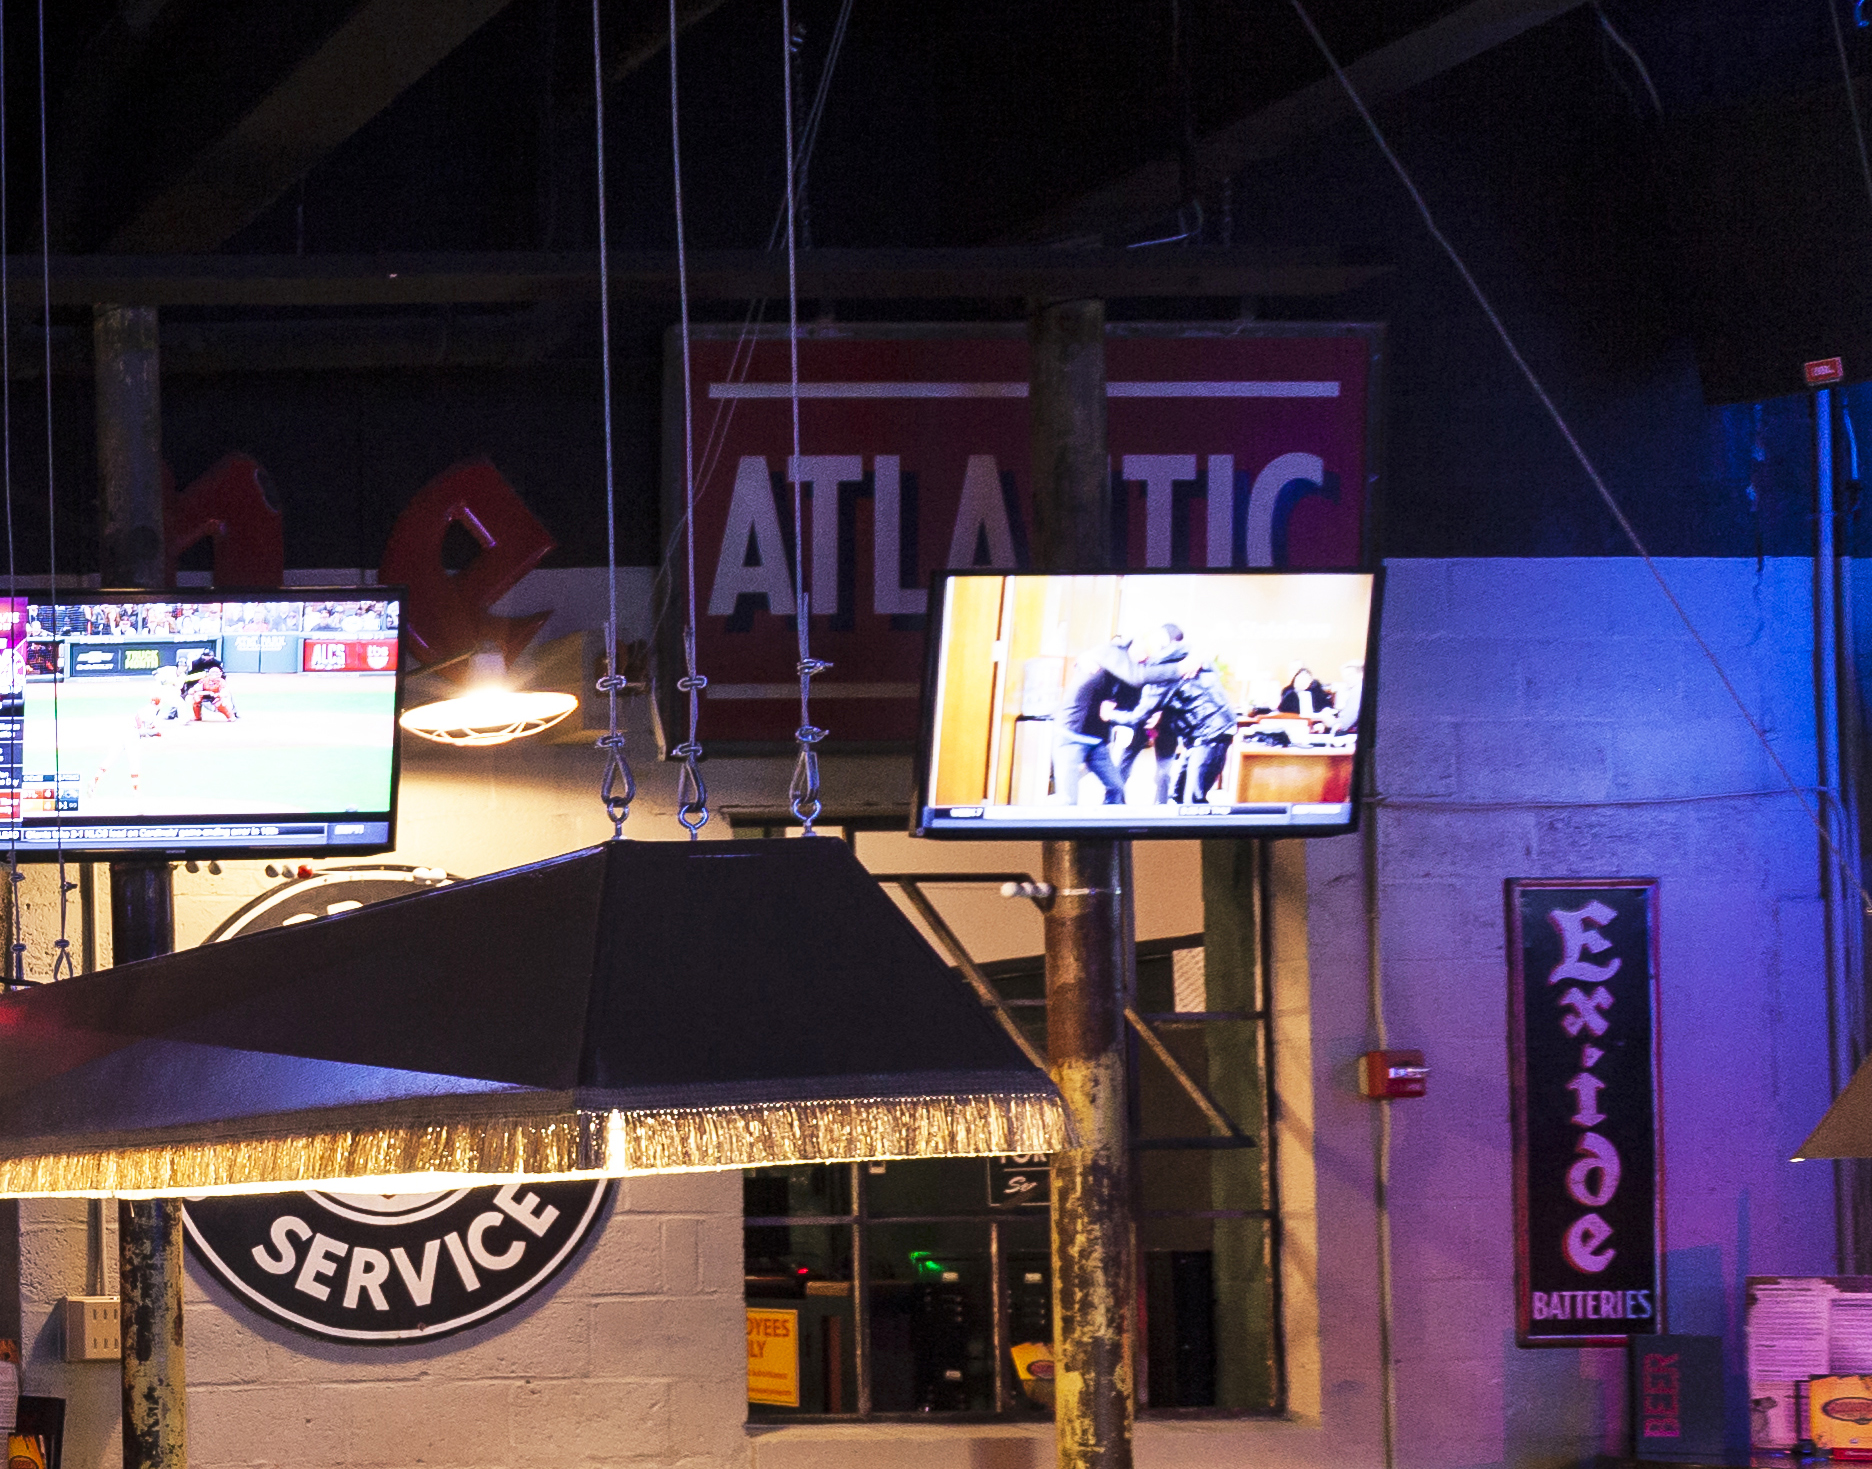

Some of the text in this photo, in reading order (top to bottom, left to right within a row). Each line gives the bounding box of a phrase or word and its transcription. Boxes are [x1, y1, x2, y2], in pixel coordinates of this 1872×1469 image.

[706, 452, 1328, 618] ATLATIC
[1547, 900, 1623, 1275] Exide
[250, 1180, 559, 1311] SERVICE
[1531, 1289, 1652, 1322] BATTERIES
[1642, 1352, 1681, 1438] BEER
